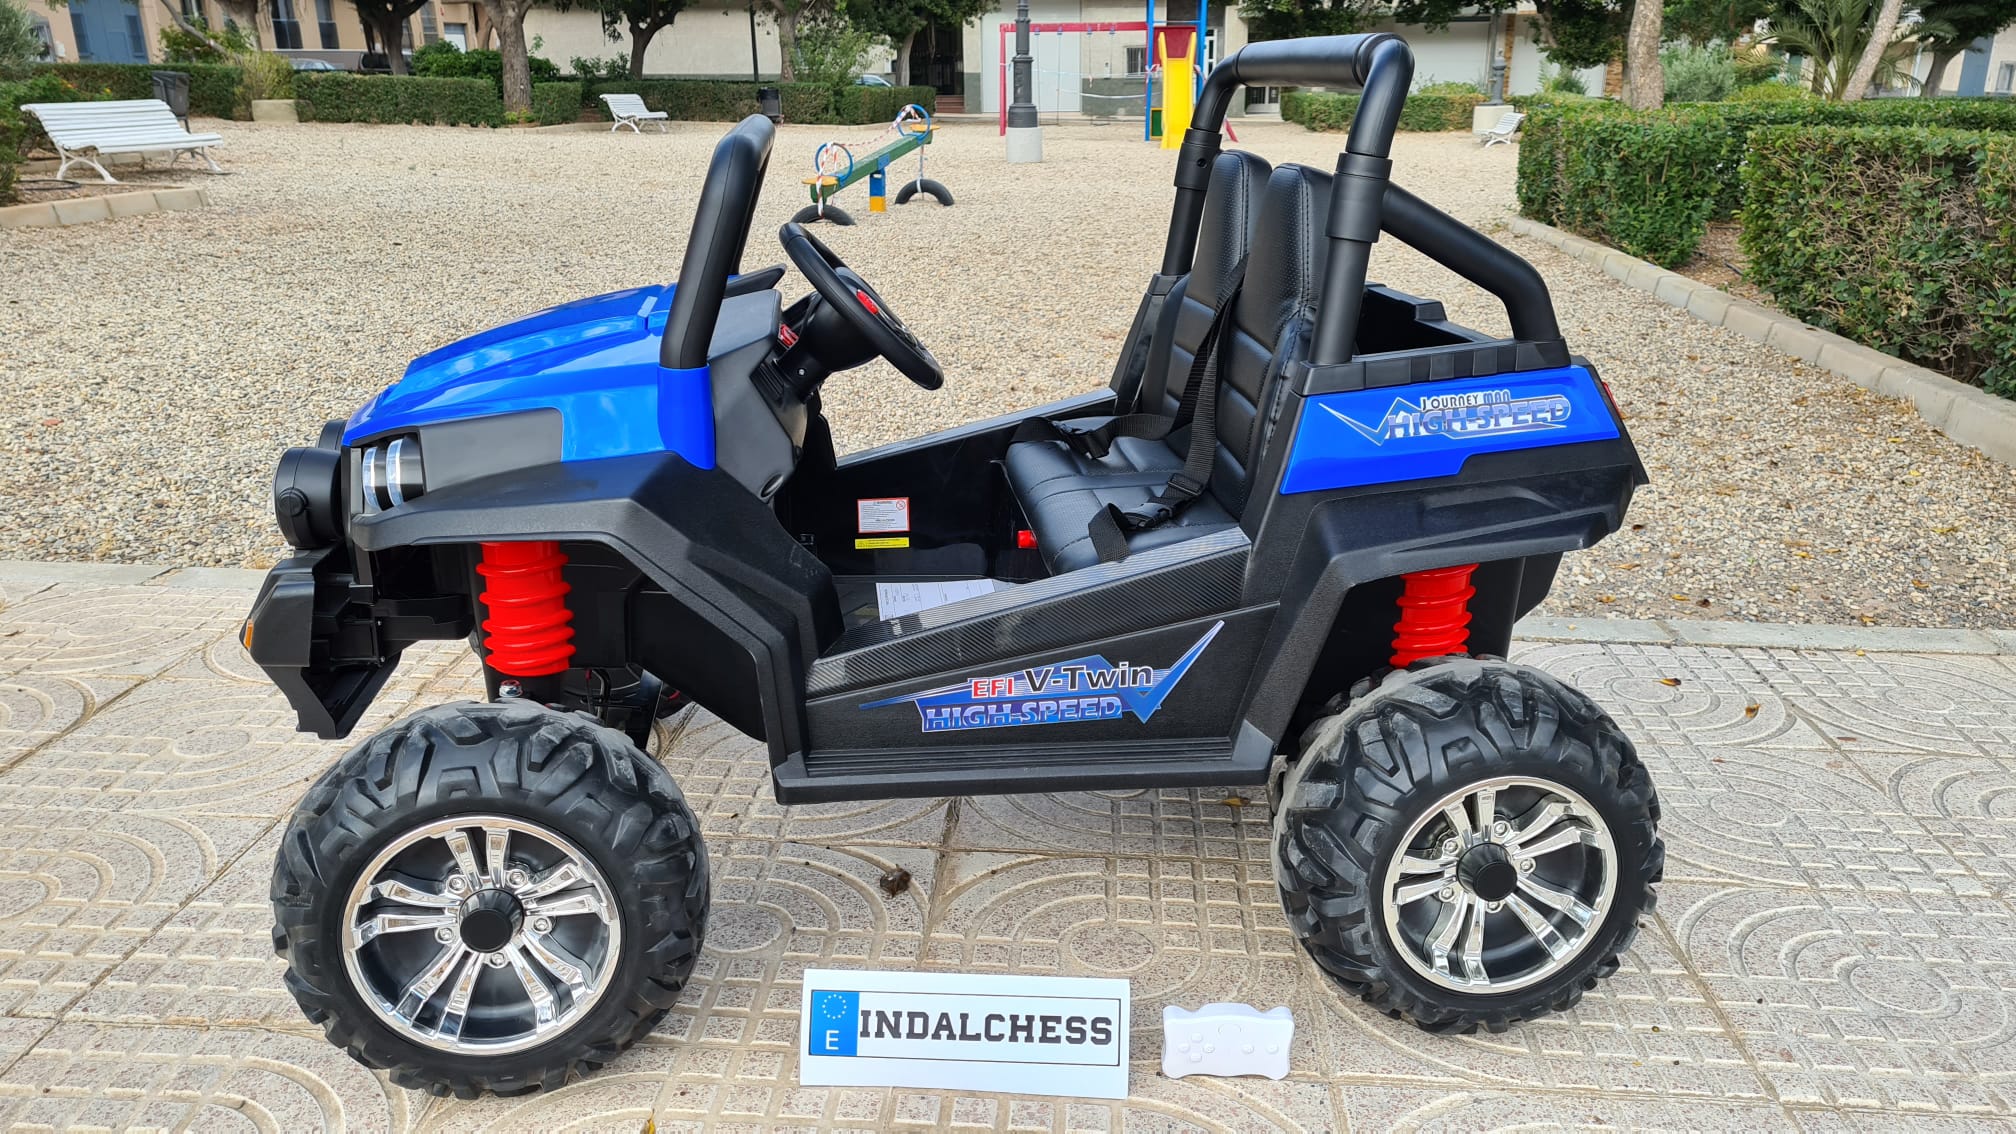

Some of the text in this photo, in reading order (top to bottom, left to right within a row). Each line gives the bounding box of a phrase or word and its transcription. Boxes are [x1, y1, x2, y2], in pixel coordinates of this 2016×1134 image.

[1422, 393, 1479, 411] JOURNEY
[972, 661, 1154, 698] EFI V-Twin
[825, 1030, 839, 1051] E
[859, 1009, 1113, 1046] INDALCHESS
